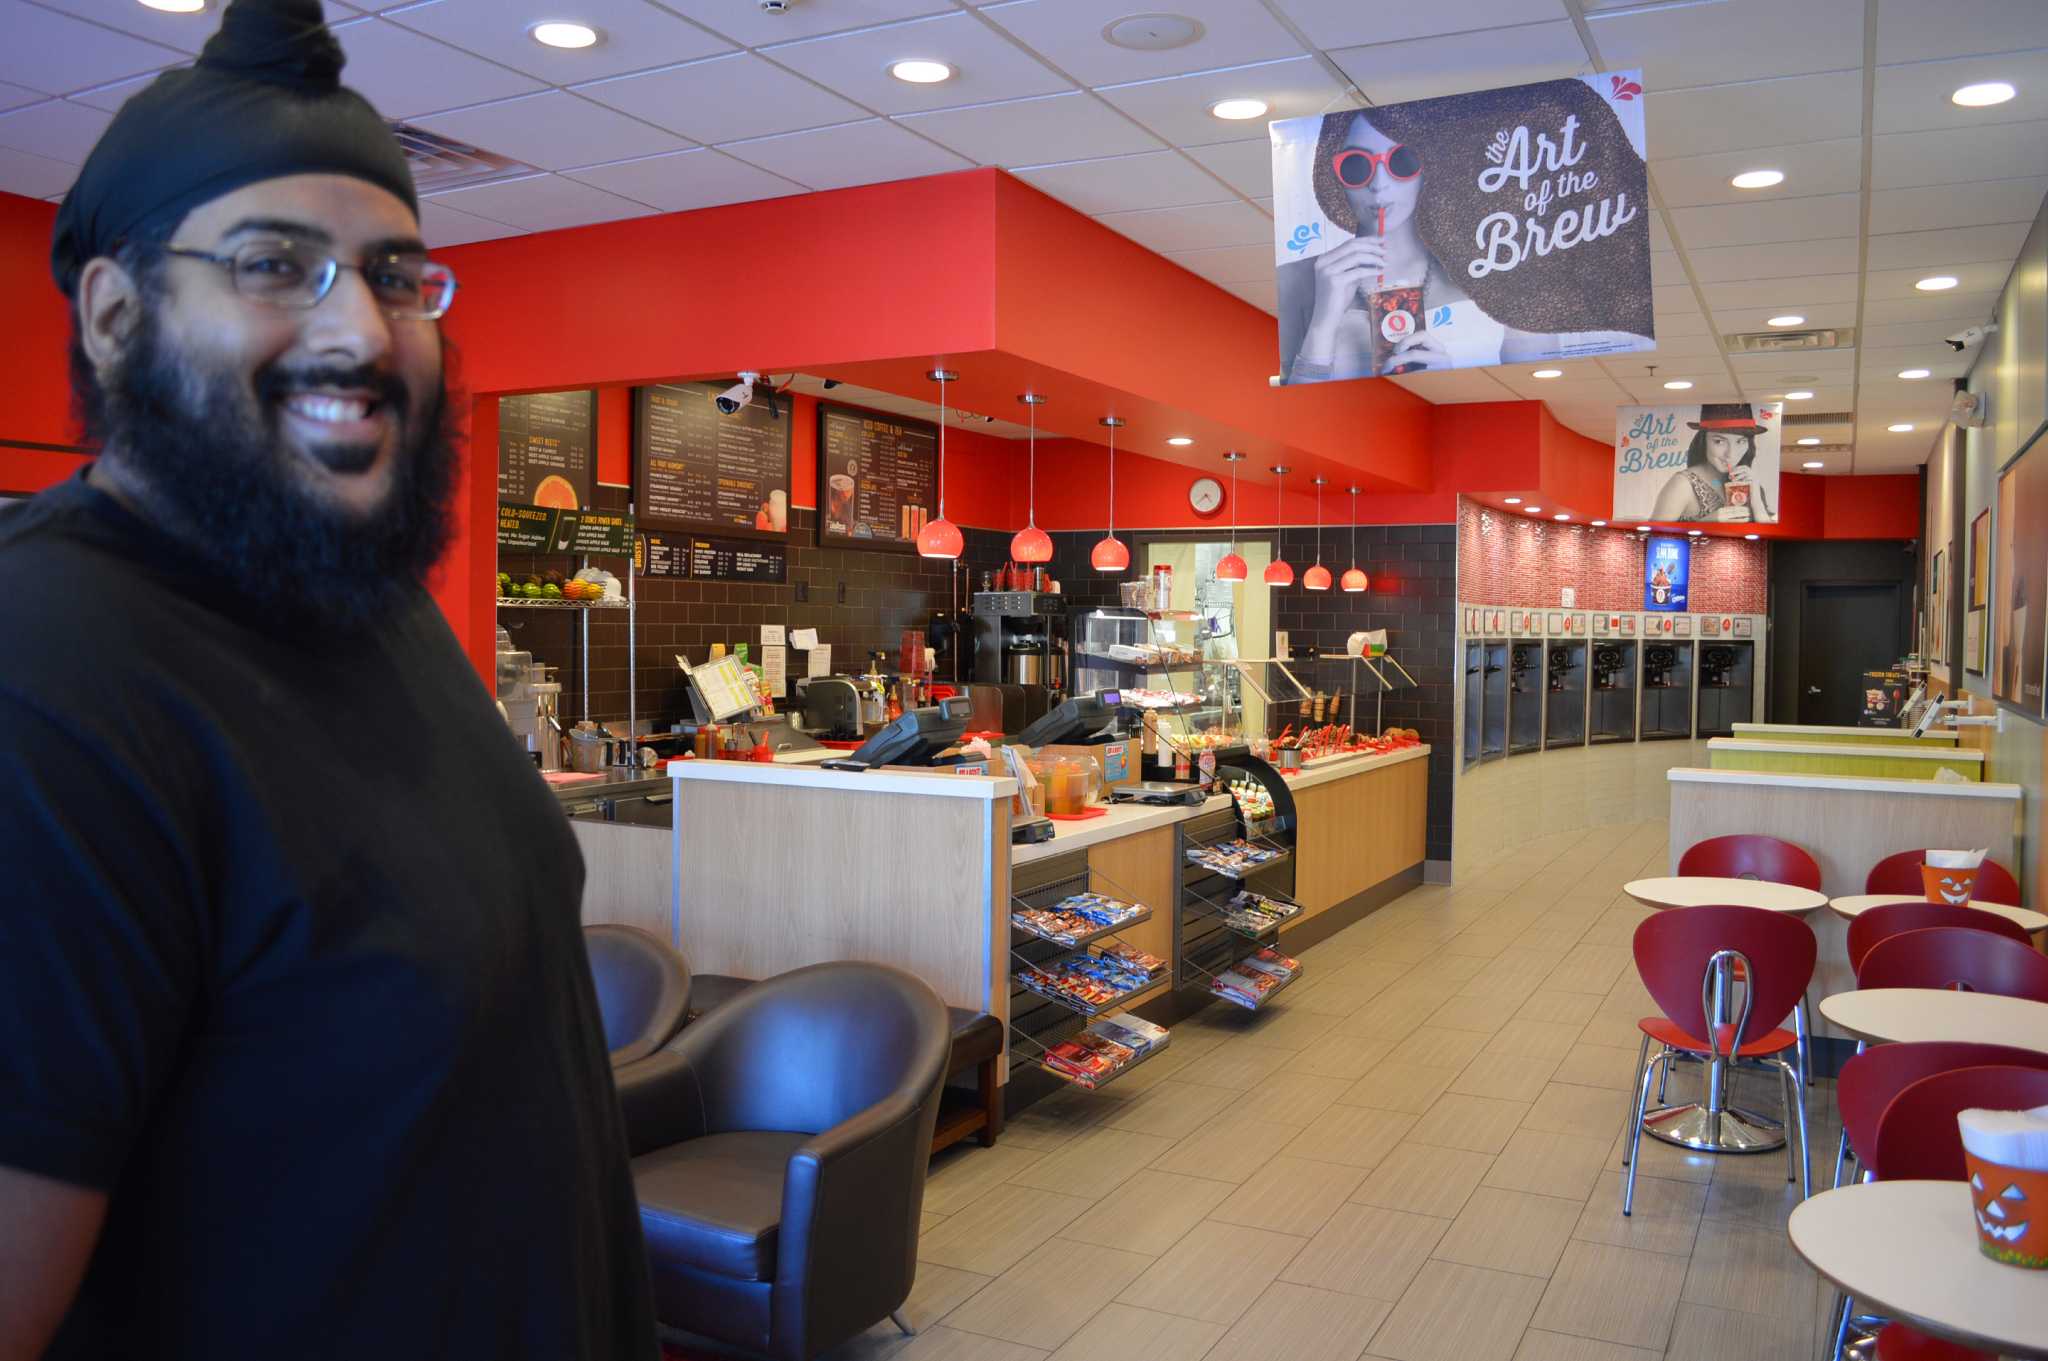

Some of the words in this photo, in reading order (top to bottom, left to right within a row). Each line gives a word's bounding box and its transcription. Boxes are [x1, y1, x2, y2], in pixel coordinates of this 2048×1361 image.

[1477, 114, 1586, 193] Art
[1485, 128, 1510, 164] the
[1523, 180, 1553, 216] of
[1557, 171, 1599, 199] the
[1467, 193, 1637, 279] Brew
[1629, 413, 1676, 439] Art
[1646, 438, 1660, 452] of
[1660, 436, 1678, 447] the
